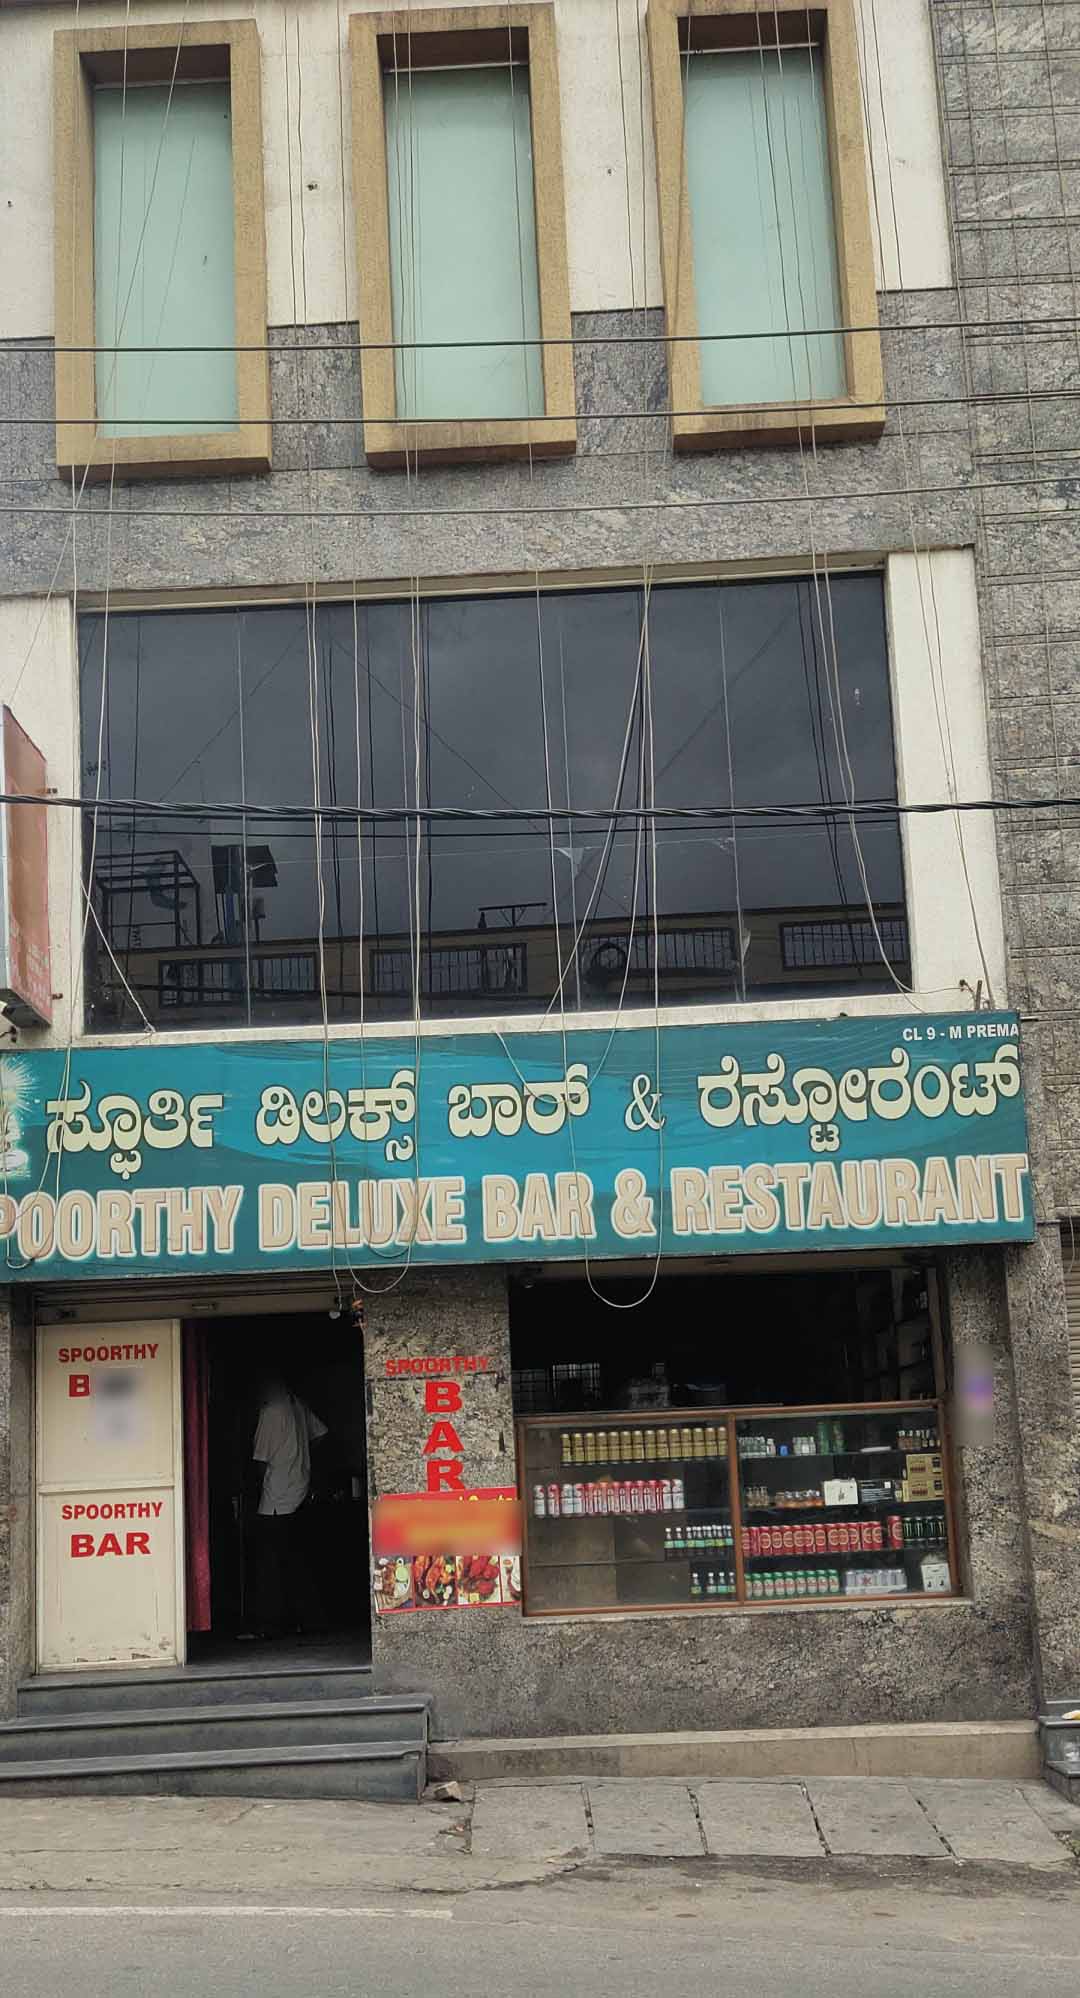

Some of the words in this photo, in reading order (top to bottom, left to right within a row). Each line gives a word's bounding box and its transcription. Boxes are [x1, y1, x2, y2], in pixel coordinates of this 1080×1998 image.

[902, 1027, 922, 1041] CL
[926, 1026, 936, 1040] 9
[949, 1025, 962, 1039] M
[966, 1023, 1019, 1038] PREMA
[255, 1069, 416, 1162] ಡಿಲಕ್ಸ್
[448, 1063, 590, 1138] ಬಾರ್
[624, 1074, 666, 1131] &
[697, 1044, 1021, 1153] ರೆಸ್ಟೋರೆಂಟ್
[258, 1176, 467, 1253] DELUXE
[481, 1171, 597, 1243] BAR
[611, 1168, 657, 1240] &
[670, 1153, 1029, 1235] RESTAURANT
[58, 1343, 159, 1363] SPOORTHY
[385, 1356, 490, 1376] SPOORTHY
[62, 1501, 163, 1520] SPOORTHY
[70, 1531, 152, 1558] BAR
